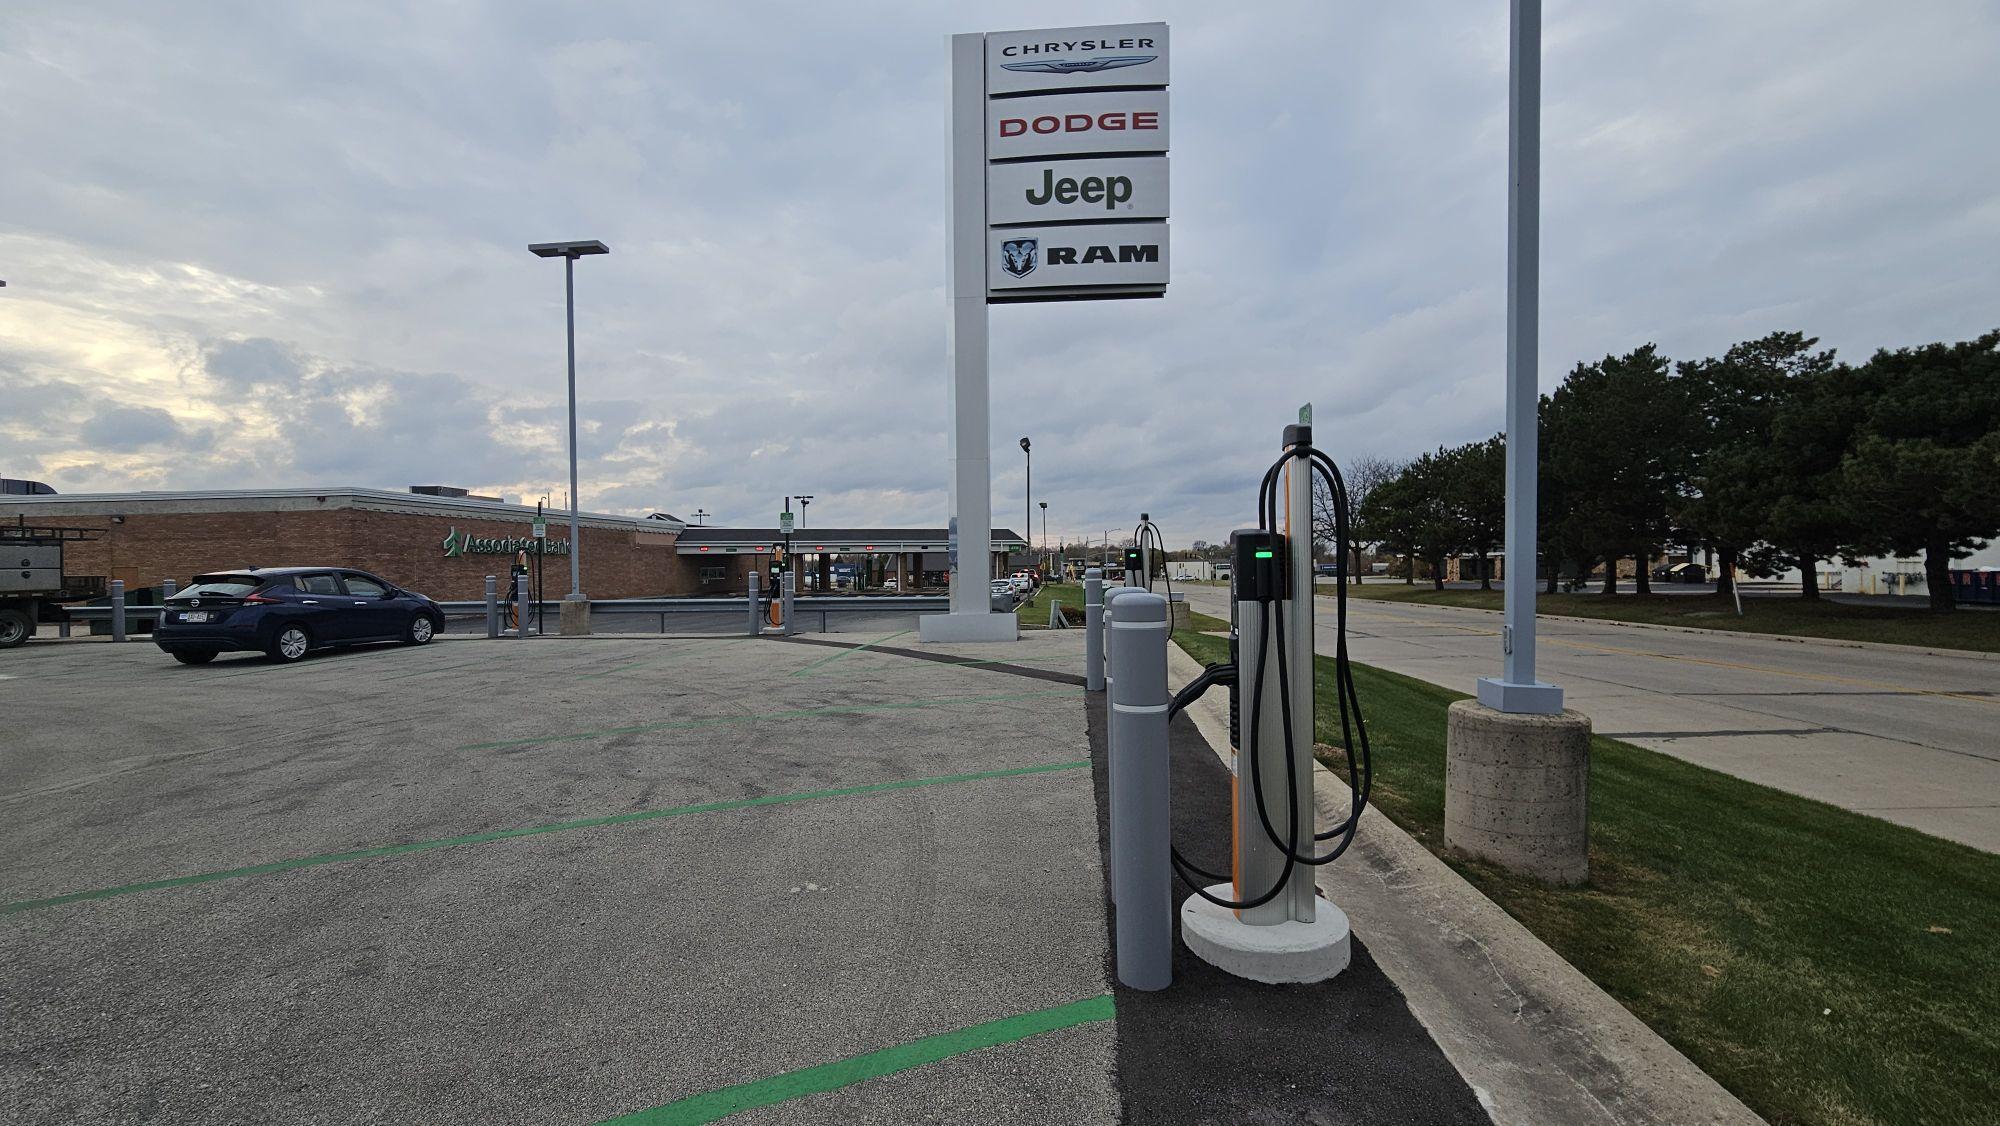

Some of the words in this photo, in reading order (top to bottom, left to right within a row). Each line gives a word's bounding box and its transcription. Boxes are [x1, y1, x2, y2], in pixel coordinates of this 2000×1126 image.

[1002, 38, 1154, 56] CHRYSLER
[1000, 112, 1159, 137] DODGE
[1025, 169, 1133, 210] Jeep
[1047, 244, 1159, 265] RAM
